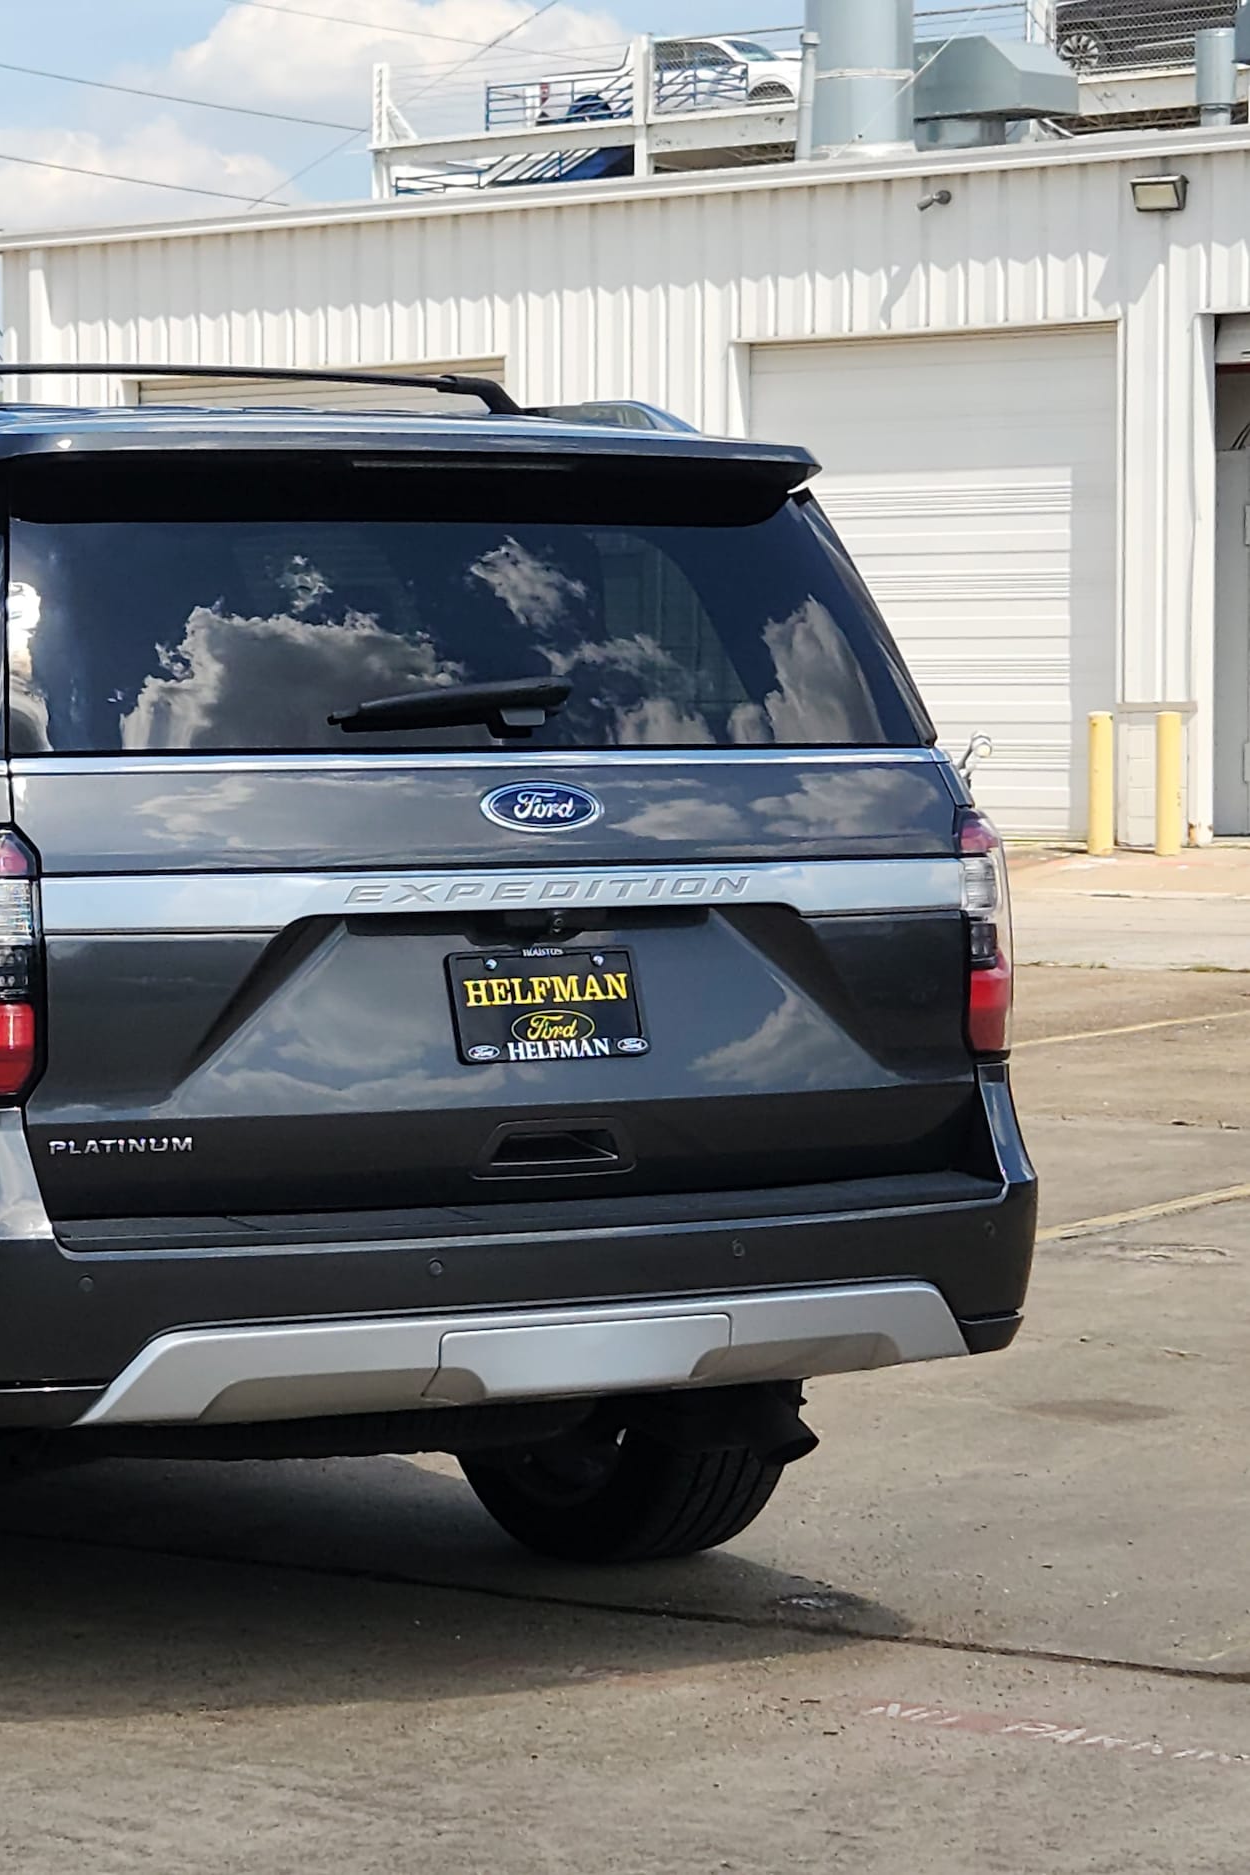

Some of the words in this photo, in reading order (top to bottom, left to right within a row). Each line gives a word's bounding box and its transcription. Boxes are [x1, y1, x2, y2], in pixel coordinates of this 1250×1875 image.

[514, 790, 577, 819] Ford
[344, 875, 750, 904] EXPEDITION
[463, 972, 629, 1007] HELFMAN
[527, 1014, 578, 1041] Ford
[507, 1037, 611, 1061] HELFMAN
[49, 1136, 193, 1155] PLATINUM
